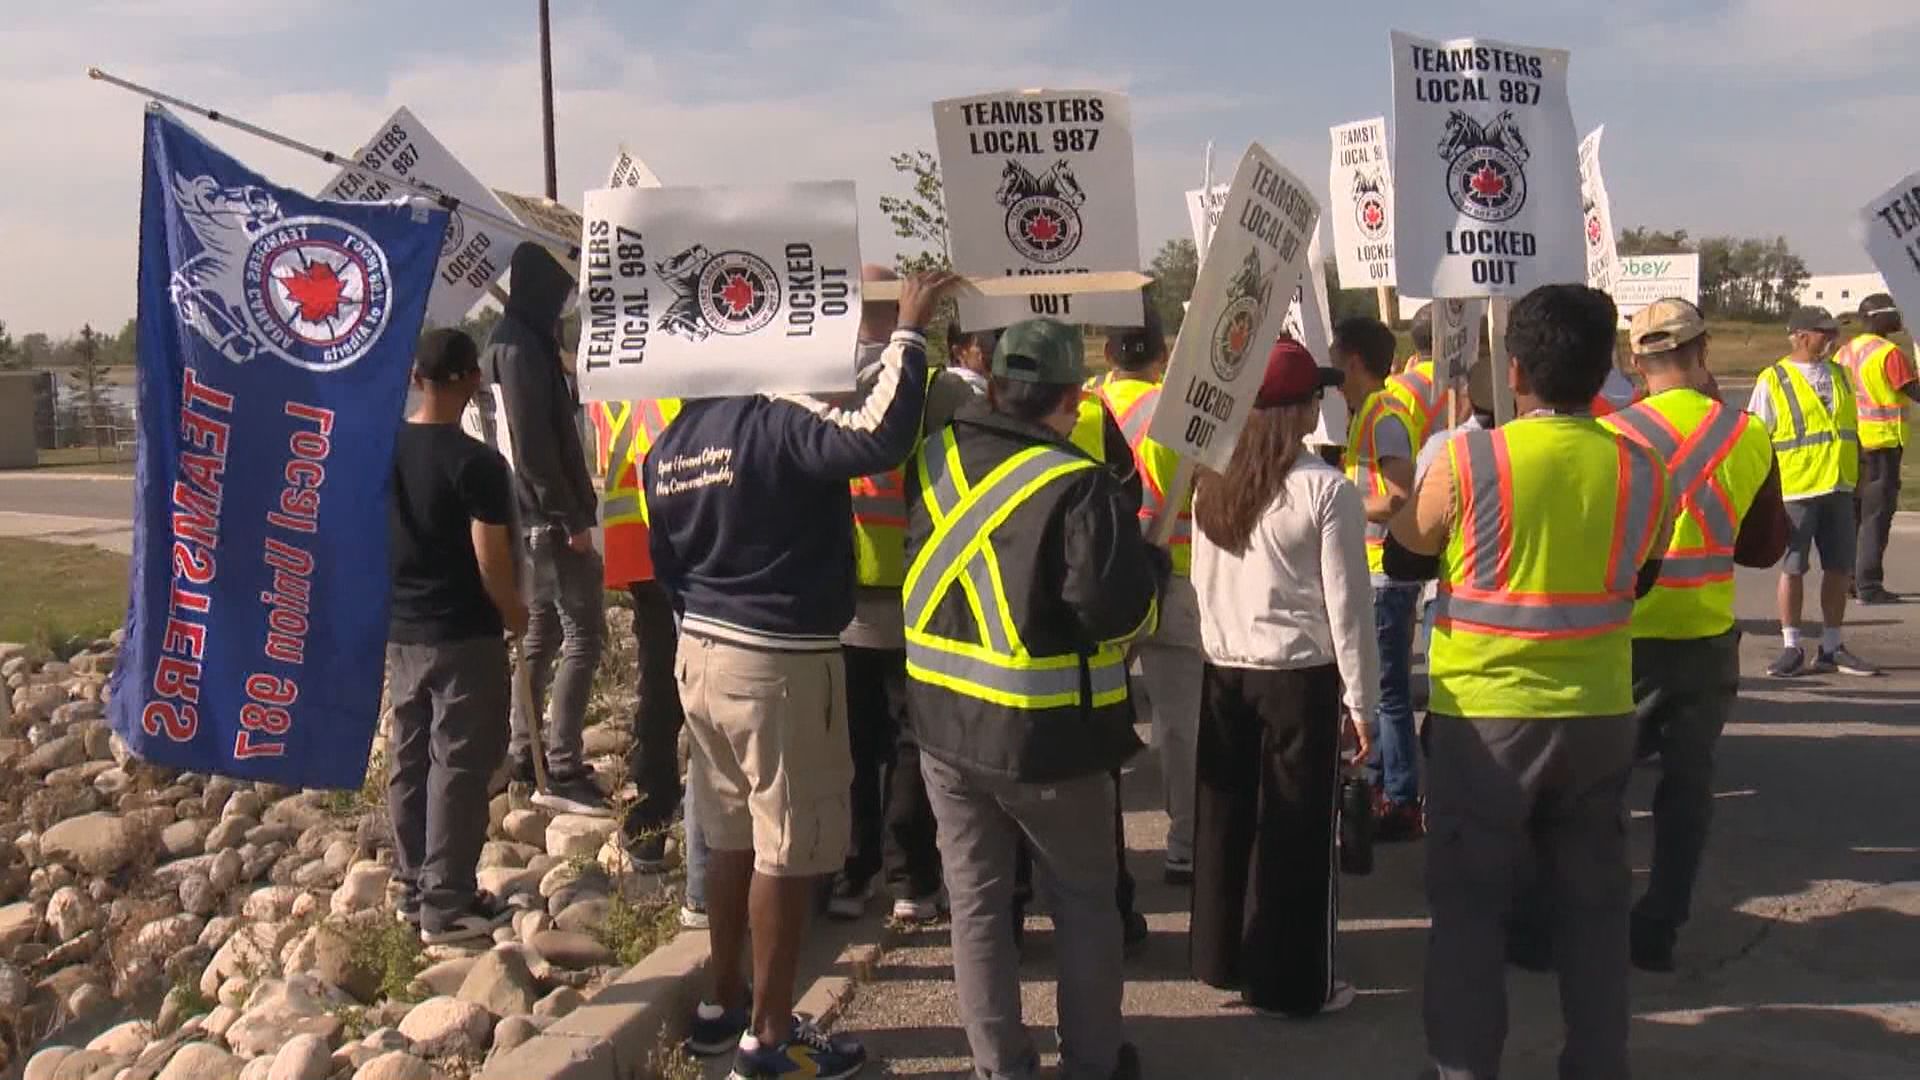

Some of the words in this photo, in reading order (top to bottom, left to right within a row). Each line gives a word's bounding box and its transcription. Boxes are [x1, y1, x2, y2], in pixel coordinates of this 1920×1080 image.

[1411, 46, 1543, 78] TEAMSTERS
[1416, 77, 1489, 103] LOCAL
[1500, 79, 1541, 106] 987
[961, 99, 1104, 126] TEAMSTERS
[969, 131, 1044, 154] LOCAL
[1053, 129, 1099, 152] 987
[1340, 149, 1369, 166] LOCAL
[392, 143, 418, 176] 987
[1240, 198, 1284, 250] LOCAL
[1878, 186, 1920, 238] TEA
[441, 231, 490, 286] LOCKED
[616, 225, 646, 278] 987
[1446, 230, 1536, 256] LOCKED
[467, 258, 496, 288] OUT
[1369, 262, 1389, 280] OUT
[1472, 259, 1519, 284] OUT
[587, 220, 616, 373] TEAMSTERS
[785, 243, 816, 337] LOCKED
[821, 265, 848, 316] OUT
[1029, 293, 1072, 314] OUT
[619, 288, 649, 365] LOCAL
[1185, 375, 1234, 421] LOCKED
[1185, 415, 1216, 451] OUT
